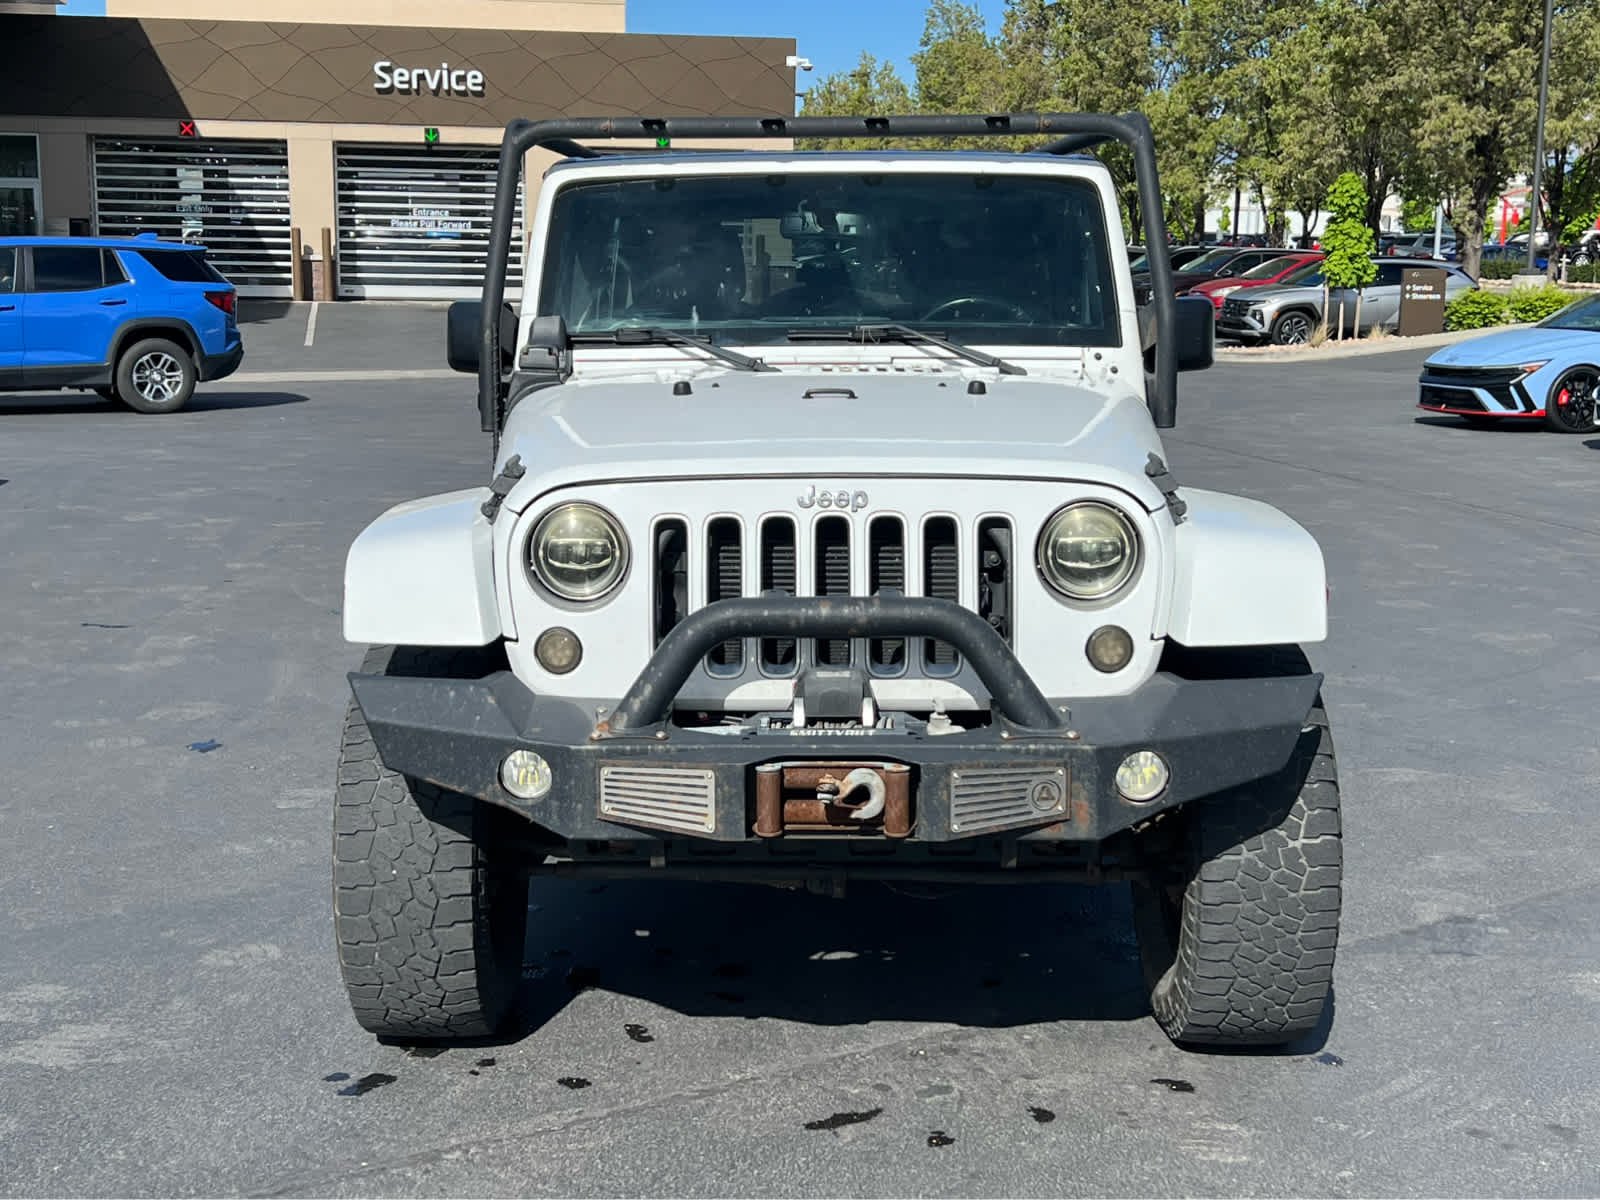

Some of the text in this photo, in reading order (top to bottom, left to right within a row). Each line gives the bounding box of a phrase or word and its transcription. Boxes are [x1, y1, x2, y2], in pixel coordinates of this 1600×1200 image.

[373, 61, 484, 92] Service
[412, 208, 450, 217] Entrance
[391, 219, 472, 230] Please Pull Forward
[797, 484, 869, 513] Jeep
